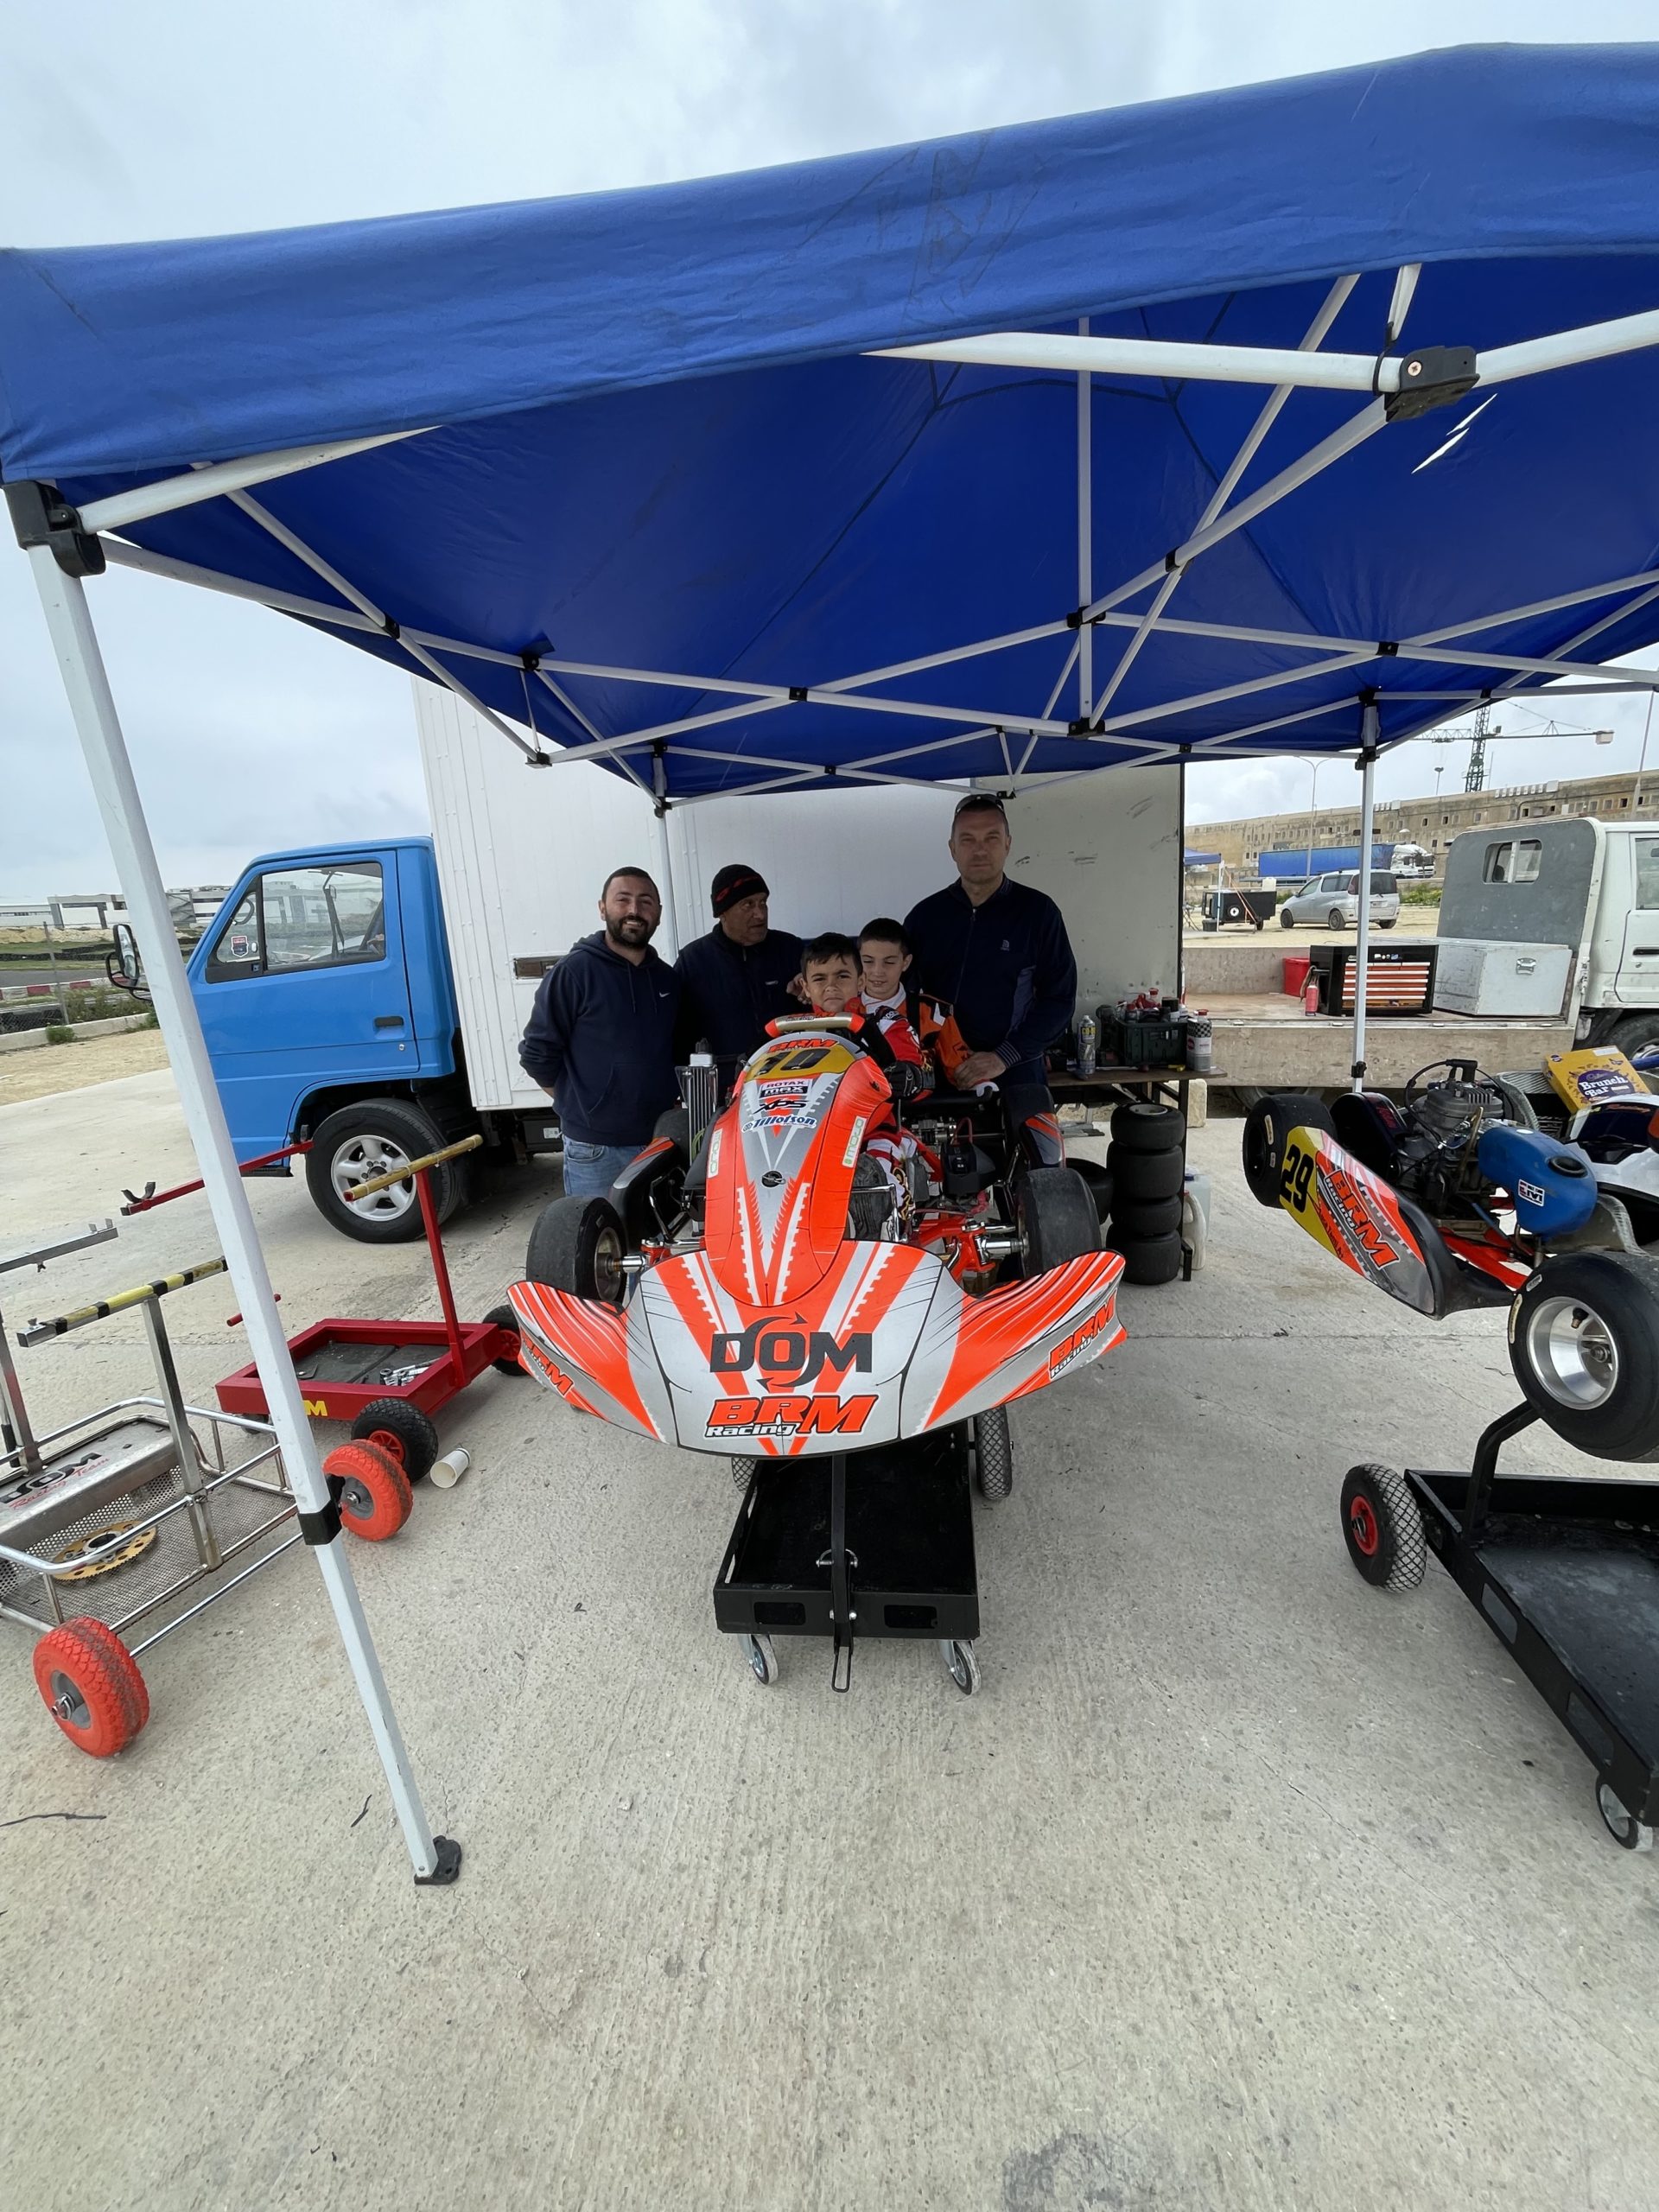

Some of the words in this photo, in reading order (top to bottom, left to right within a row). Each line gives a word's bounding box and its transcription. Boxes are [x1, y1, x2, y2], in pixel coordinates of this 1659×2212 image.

[753, 1048, 830, 1077] 10
[1579, 1075, 1629, 1090] Brunch
[1585, 1086, 1610, 1097] Bar
[753, 1115, 817, 1128] Tillotson
[1280, 1143, 1314, 1213] 29
[1325, 1169, 1400, 1268] BRM
[1050, 1290, 1116, 1371] BRM
[710, 1322, 873, 1382] DOM
[705, 1424, 798, 1438] Racing
[707, 1395, 880, 1434] BRM
[0, 1452, 102, 1503] DOM
